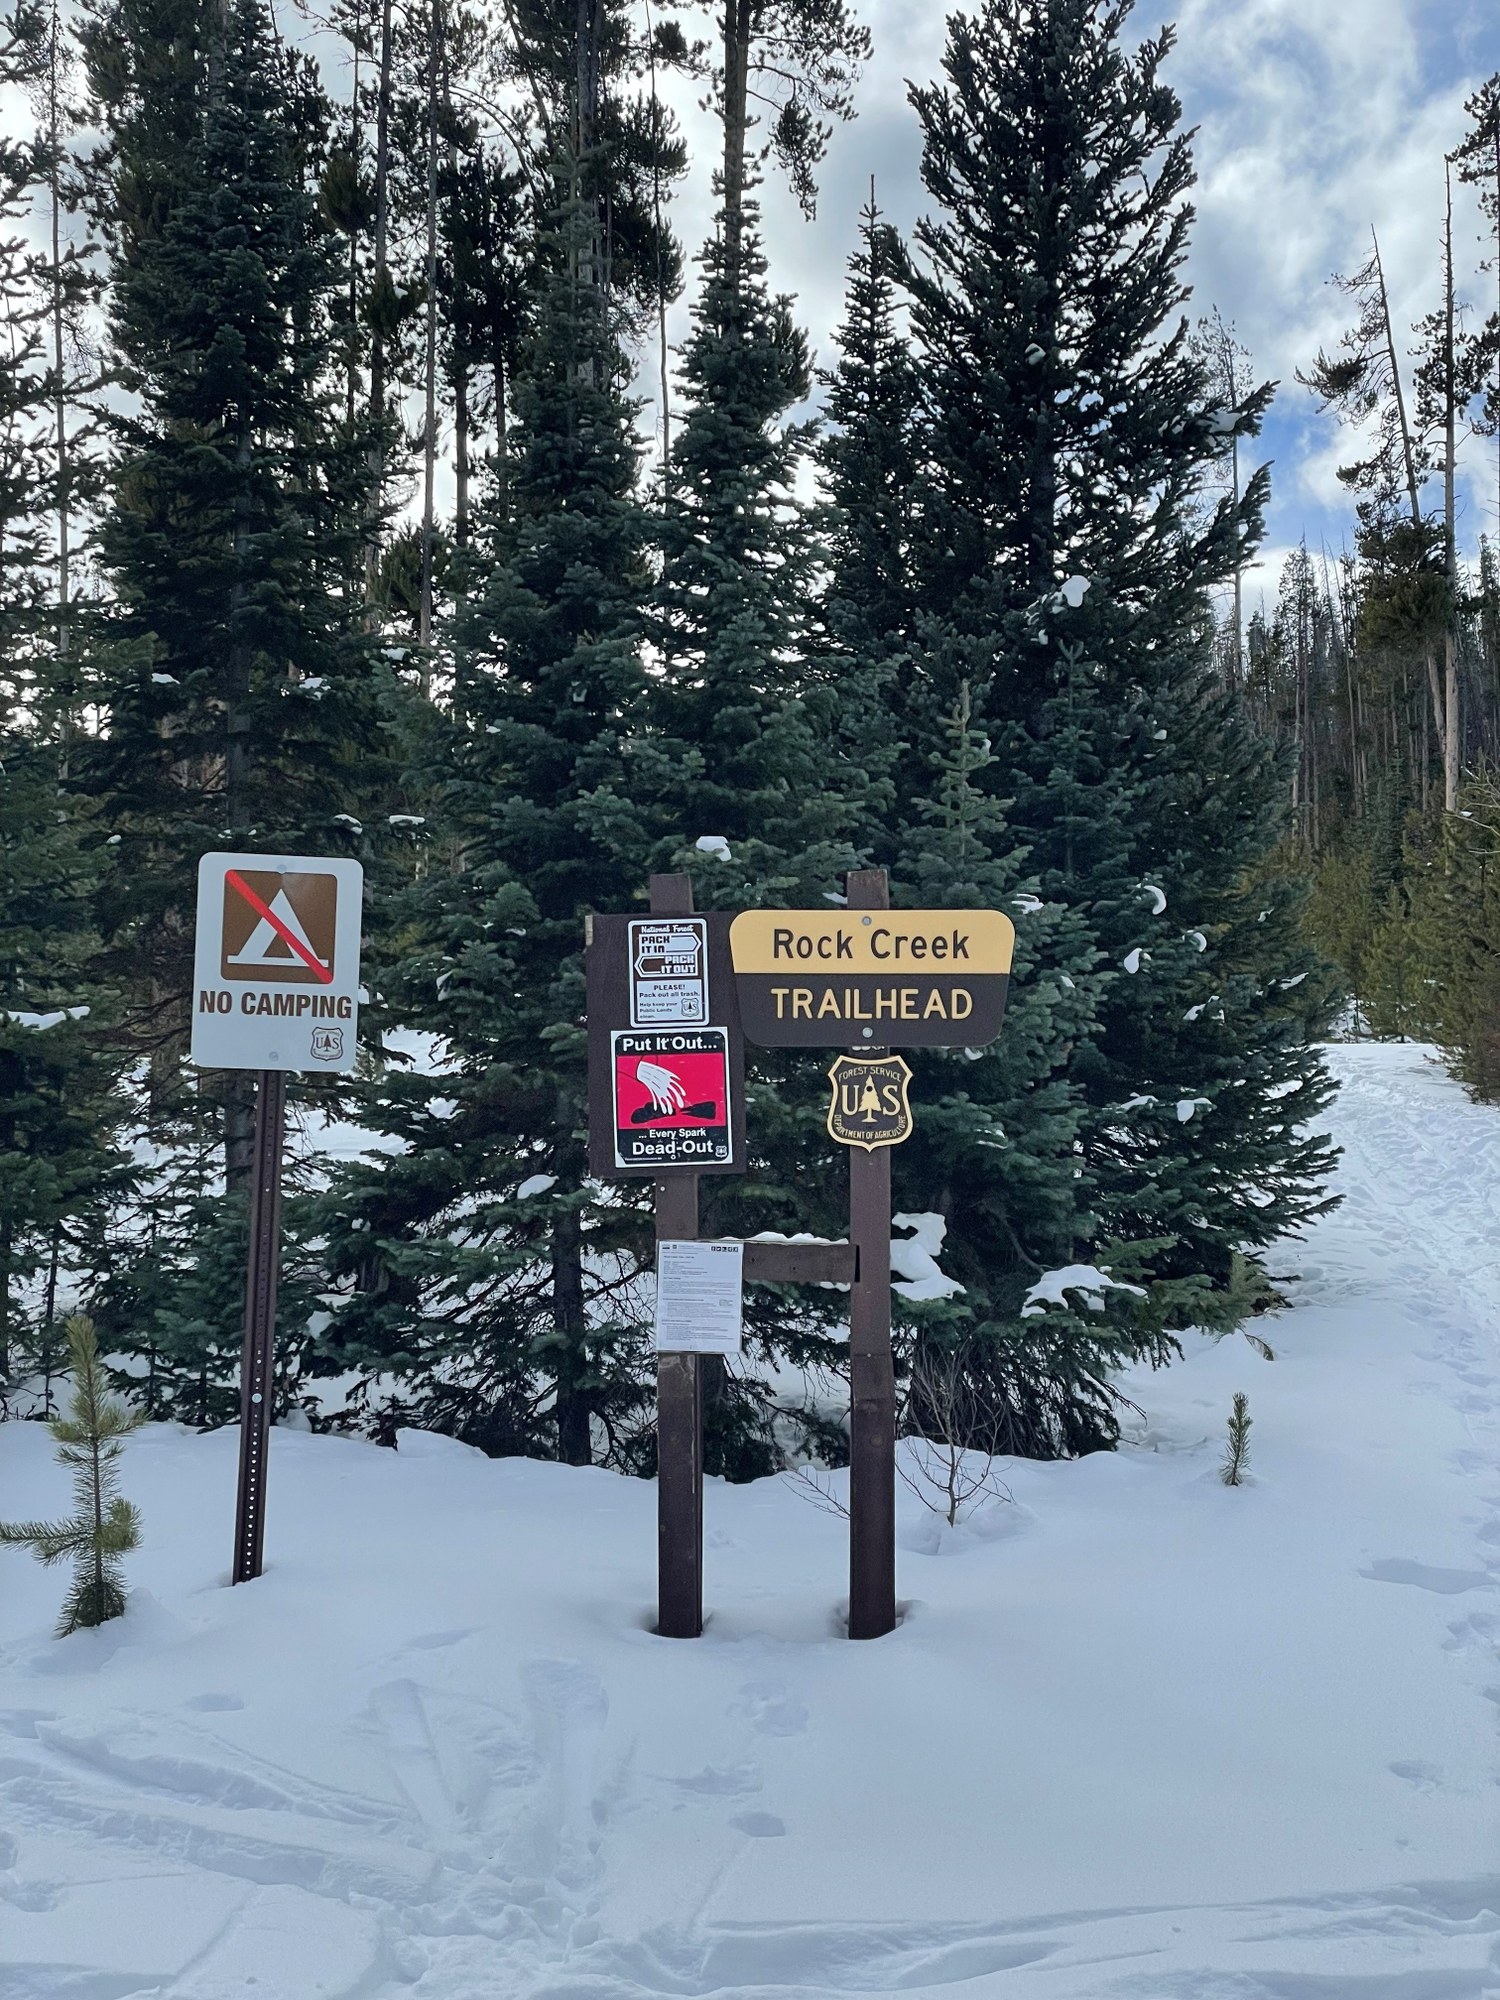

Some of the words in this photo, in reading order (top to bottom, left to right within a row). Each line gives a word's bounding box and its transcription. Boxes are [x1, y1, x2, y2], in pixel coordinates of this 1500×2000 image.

[641, 925, 670, 934] National
[672, 924, 694, 933] Forest
[641, 935, 670, 944] PACK
[773, 928, 853, 960] Rock
[870, 928, 970, 960] Creek
[664, 955, 695, 964] PACK
[661, 965, 672, 974] IT
[673, 964, 695, 973] OUT
[199, 990, 233, 1014] NO
[241, 991, 352, 1019] CAMPING
[770, 988, 973, 1020] TRAILHEAD
[623, 1037, 651, 1051] Put
[656, 1037, 667, 1050] It
[838, 1066, 868, 1082] FOREST
[870, 1066, 902, 1082] SERVICE
[649, 1129, 676, 1140] Every
[679, 1128, 706, 1138] Spark
[834, 1114, 865, 1139] DEPARTMENT
[865, 1131, 874, 1140] OF
[874, 1114, 906, 1139] AGRICULTURE
[632, 1140, 714, 1156] Dead-Out
